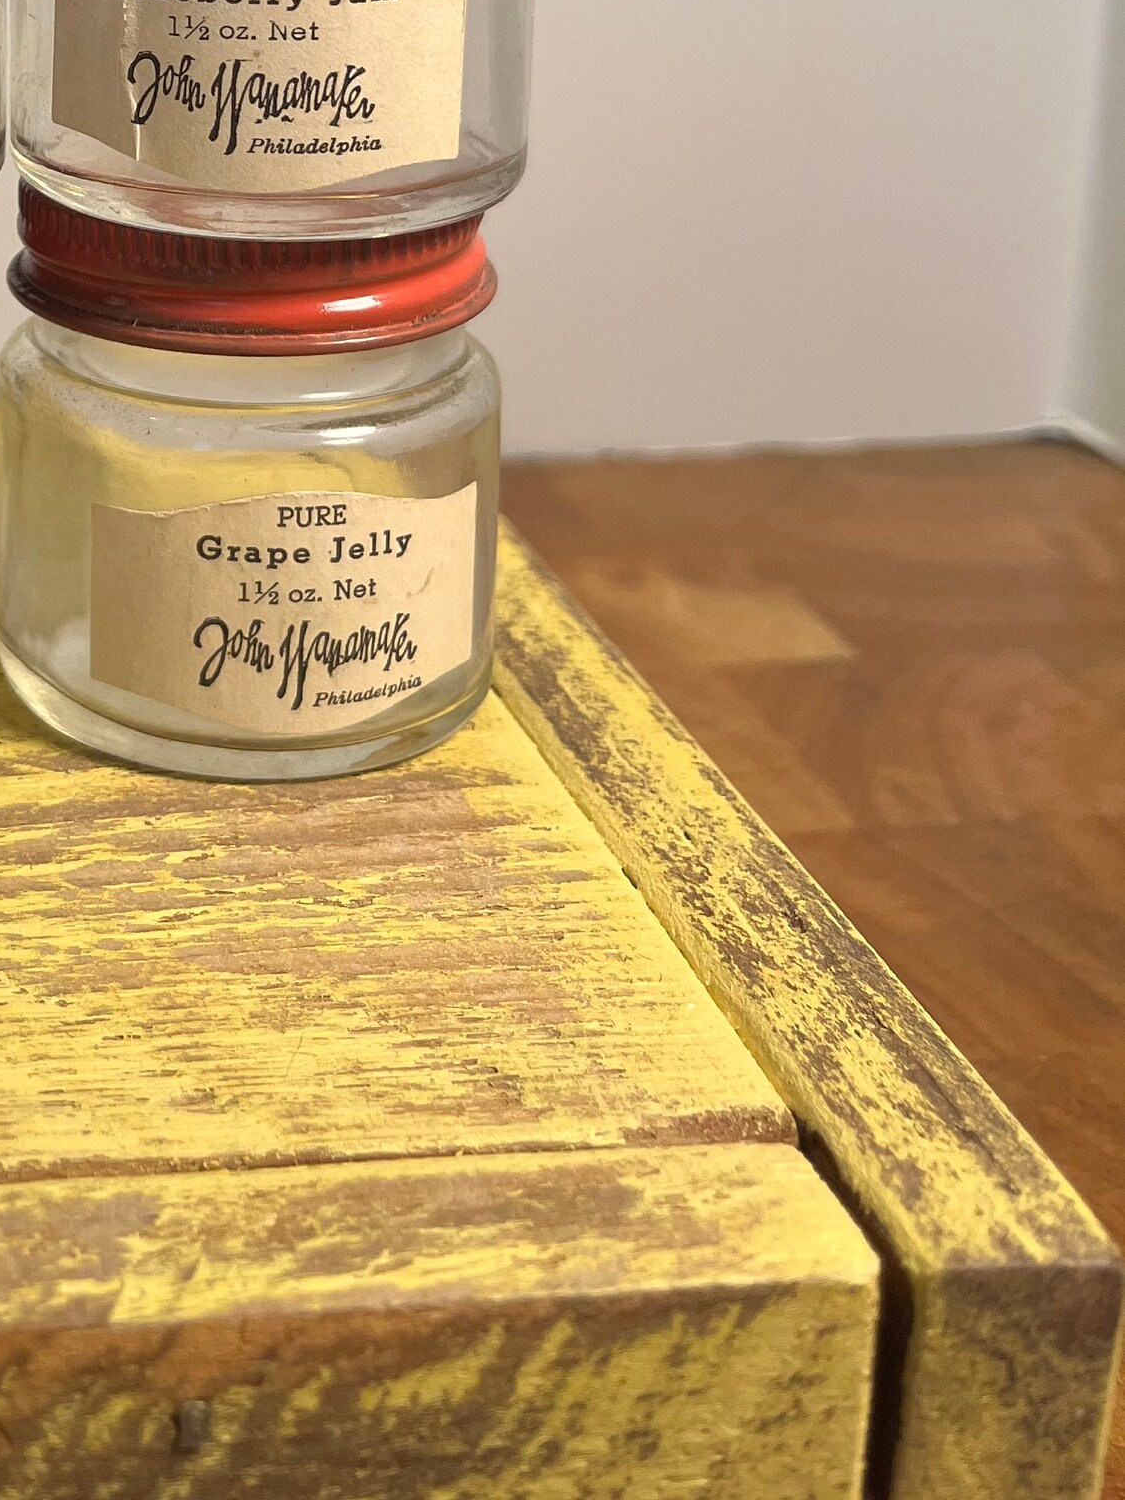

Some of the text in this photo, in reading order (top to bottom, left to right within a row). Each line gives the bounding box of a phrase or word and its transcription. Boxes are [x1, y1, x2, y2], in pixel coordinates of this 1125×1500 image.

[219, 23, 257, 40] oz.
[269, 20, 319, 41] Net
[127, 51, 206, 125] John
[247, 135, 382, 155] Philadelphia
[277, 505, 347, 527] PURE
[196, 530, 412, 569] Grape Jelly
[288, 588, 323, 602] oz.
[334, 578, 376, 601] Net
[193, 616, 274, 687] John
[313, 675, 423, 707] Philadelphia
